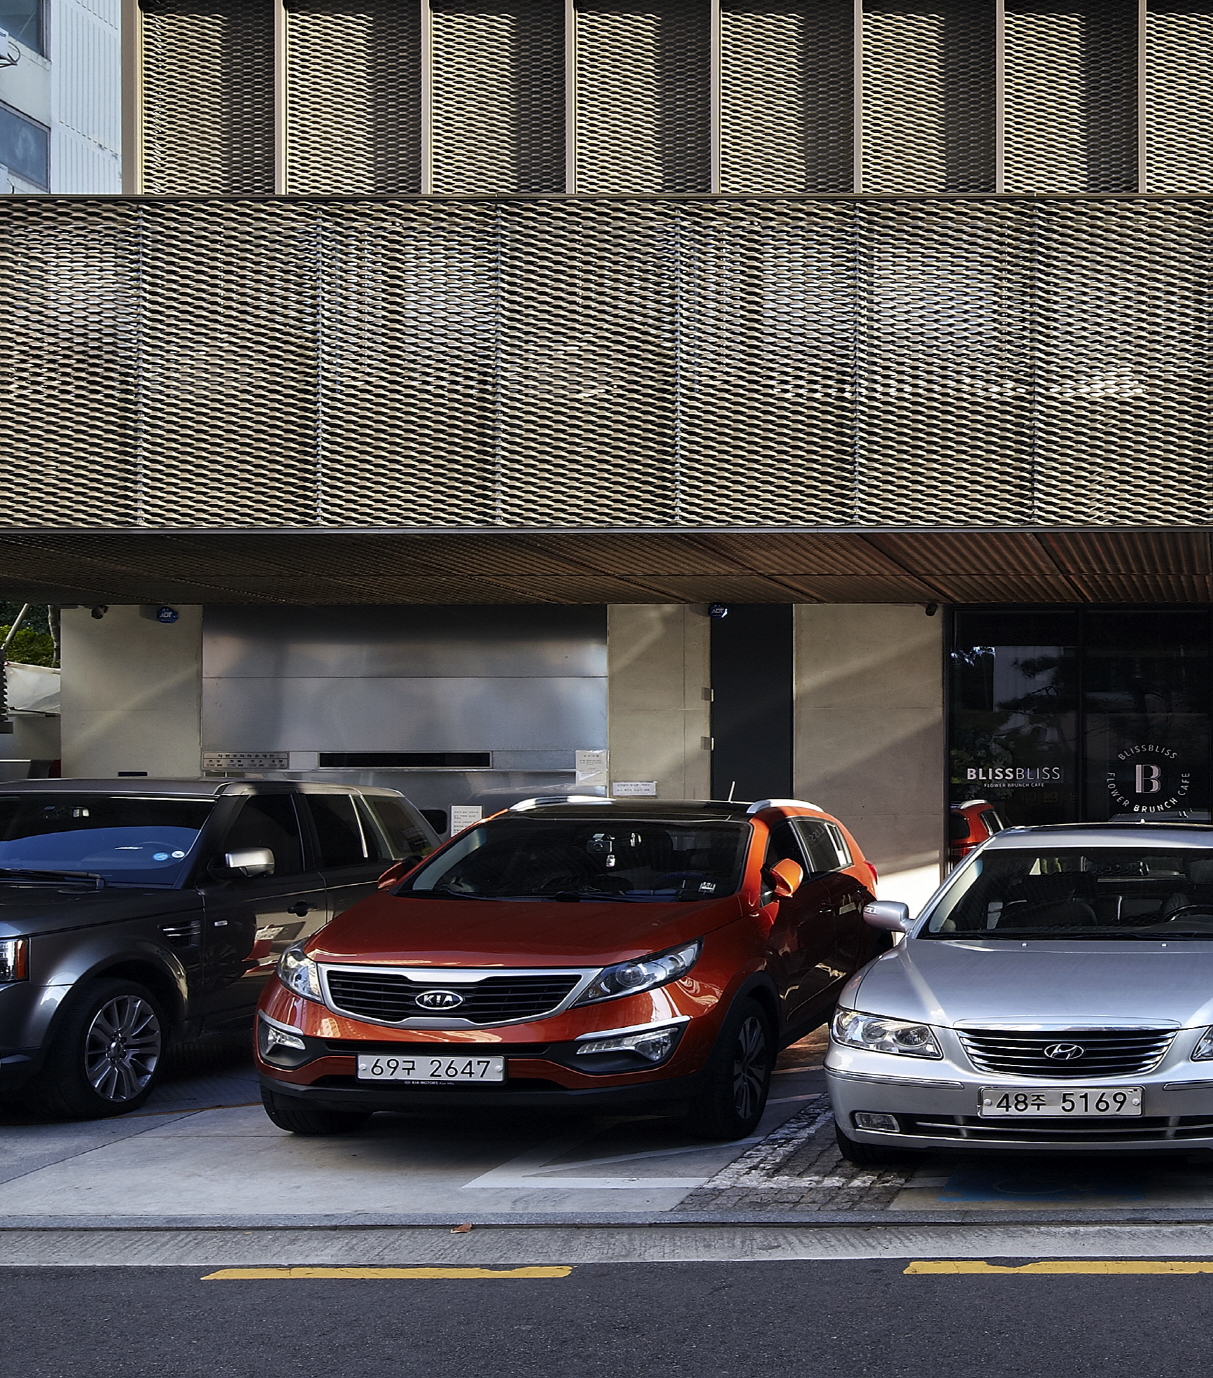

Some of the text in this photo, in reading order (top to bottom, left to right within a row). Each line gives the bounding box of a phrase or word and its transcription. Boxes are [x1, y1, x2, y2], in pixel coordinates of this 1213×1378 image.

[1118, 744, 1178, 761] BLISSBLISS
[967, 767, 1060, 780] BLISSBLISS
[1135, 764, 1162, 794] B
[1106, 772, 1190, 813] FLOWER BRUNCH CAFE
[423, 994, 455, 1006] KIA
[371, 1058, 491, 1078] 69구 2647
[996, 1092, 1127, 1113] 48주 5169
